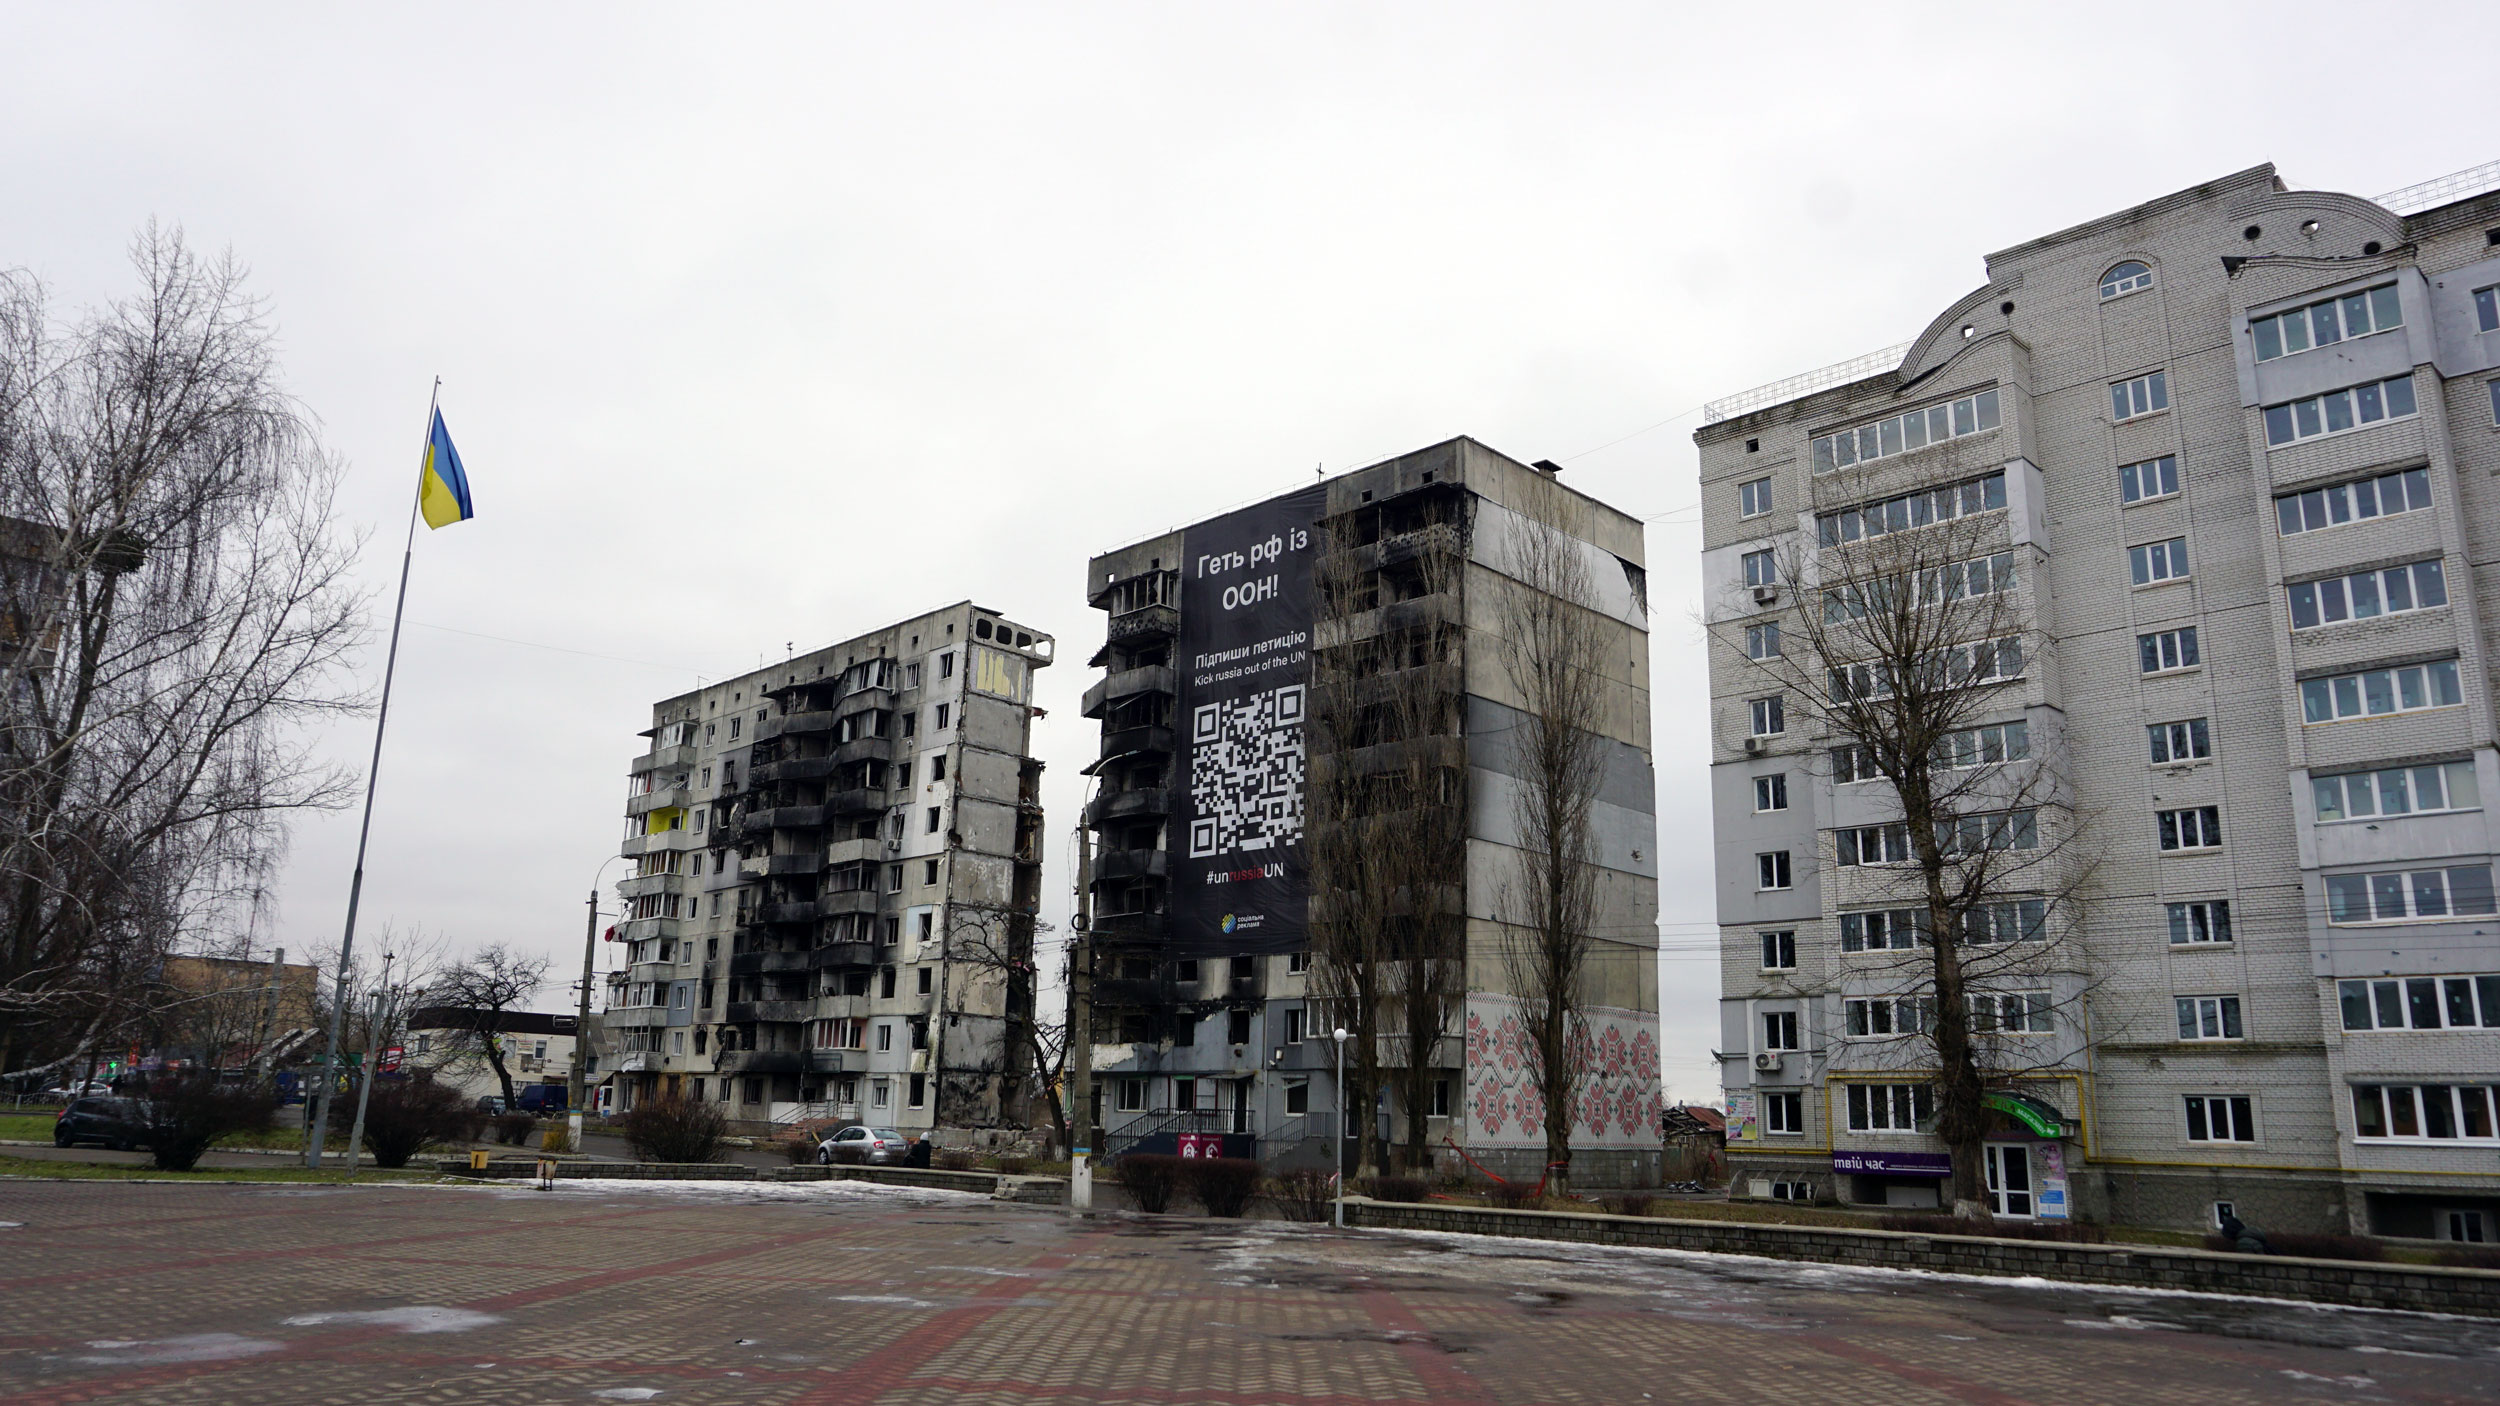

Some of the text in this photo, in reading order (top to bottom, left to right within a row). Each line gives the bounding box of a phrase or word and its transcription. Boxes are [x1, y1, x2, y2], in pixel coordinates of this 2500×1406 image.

[1198, 527, 1308, 579] Геть рф із
[1222, 574, 1278, 611] ООН!
[1195, 630, 1307, 670] Підпиши петицію
[1194, 650, 1306, 687] Kick russia out of the UN
[1206, 862, 1284, 885] #unrussiaUN
[1237, 914, 1264, 922] соціальна
[1237, 922, 1260, 930] реклама
[1834, 1156, 1863, 1169] твій
[1865, 1160, 1885, 1170] час
